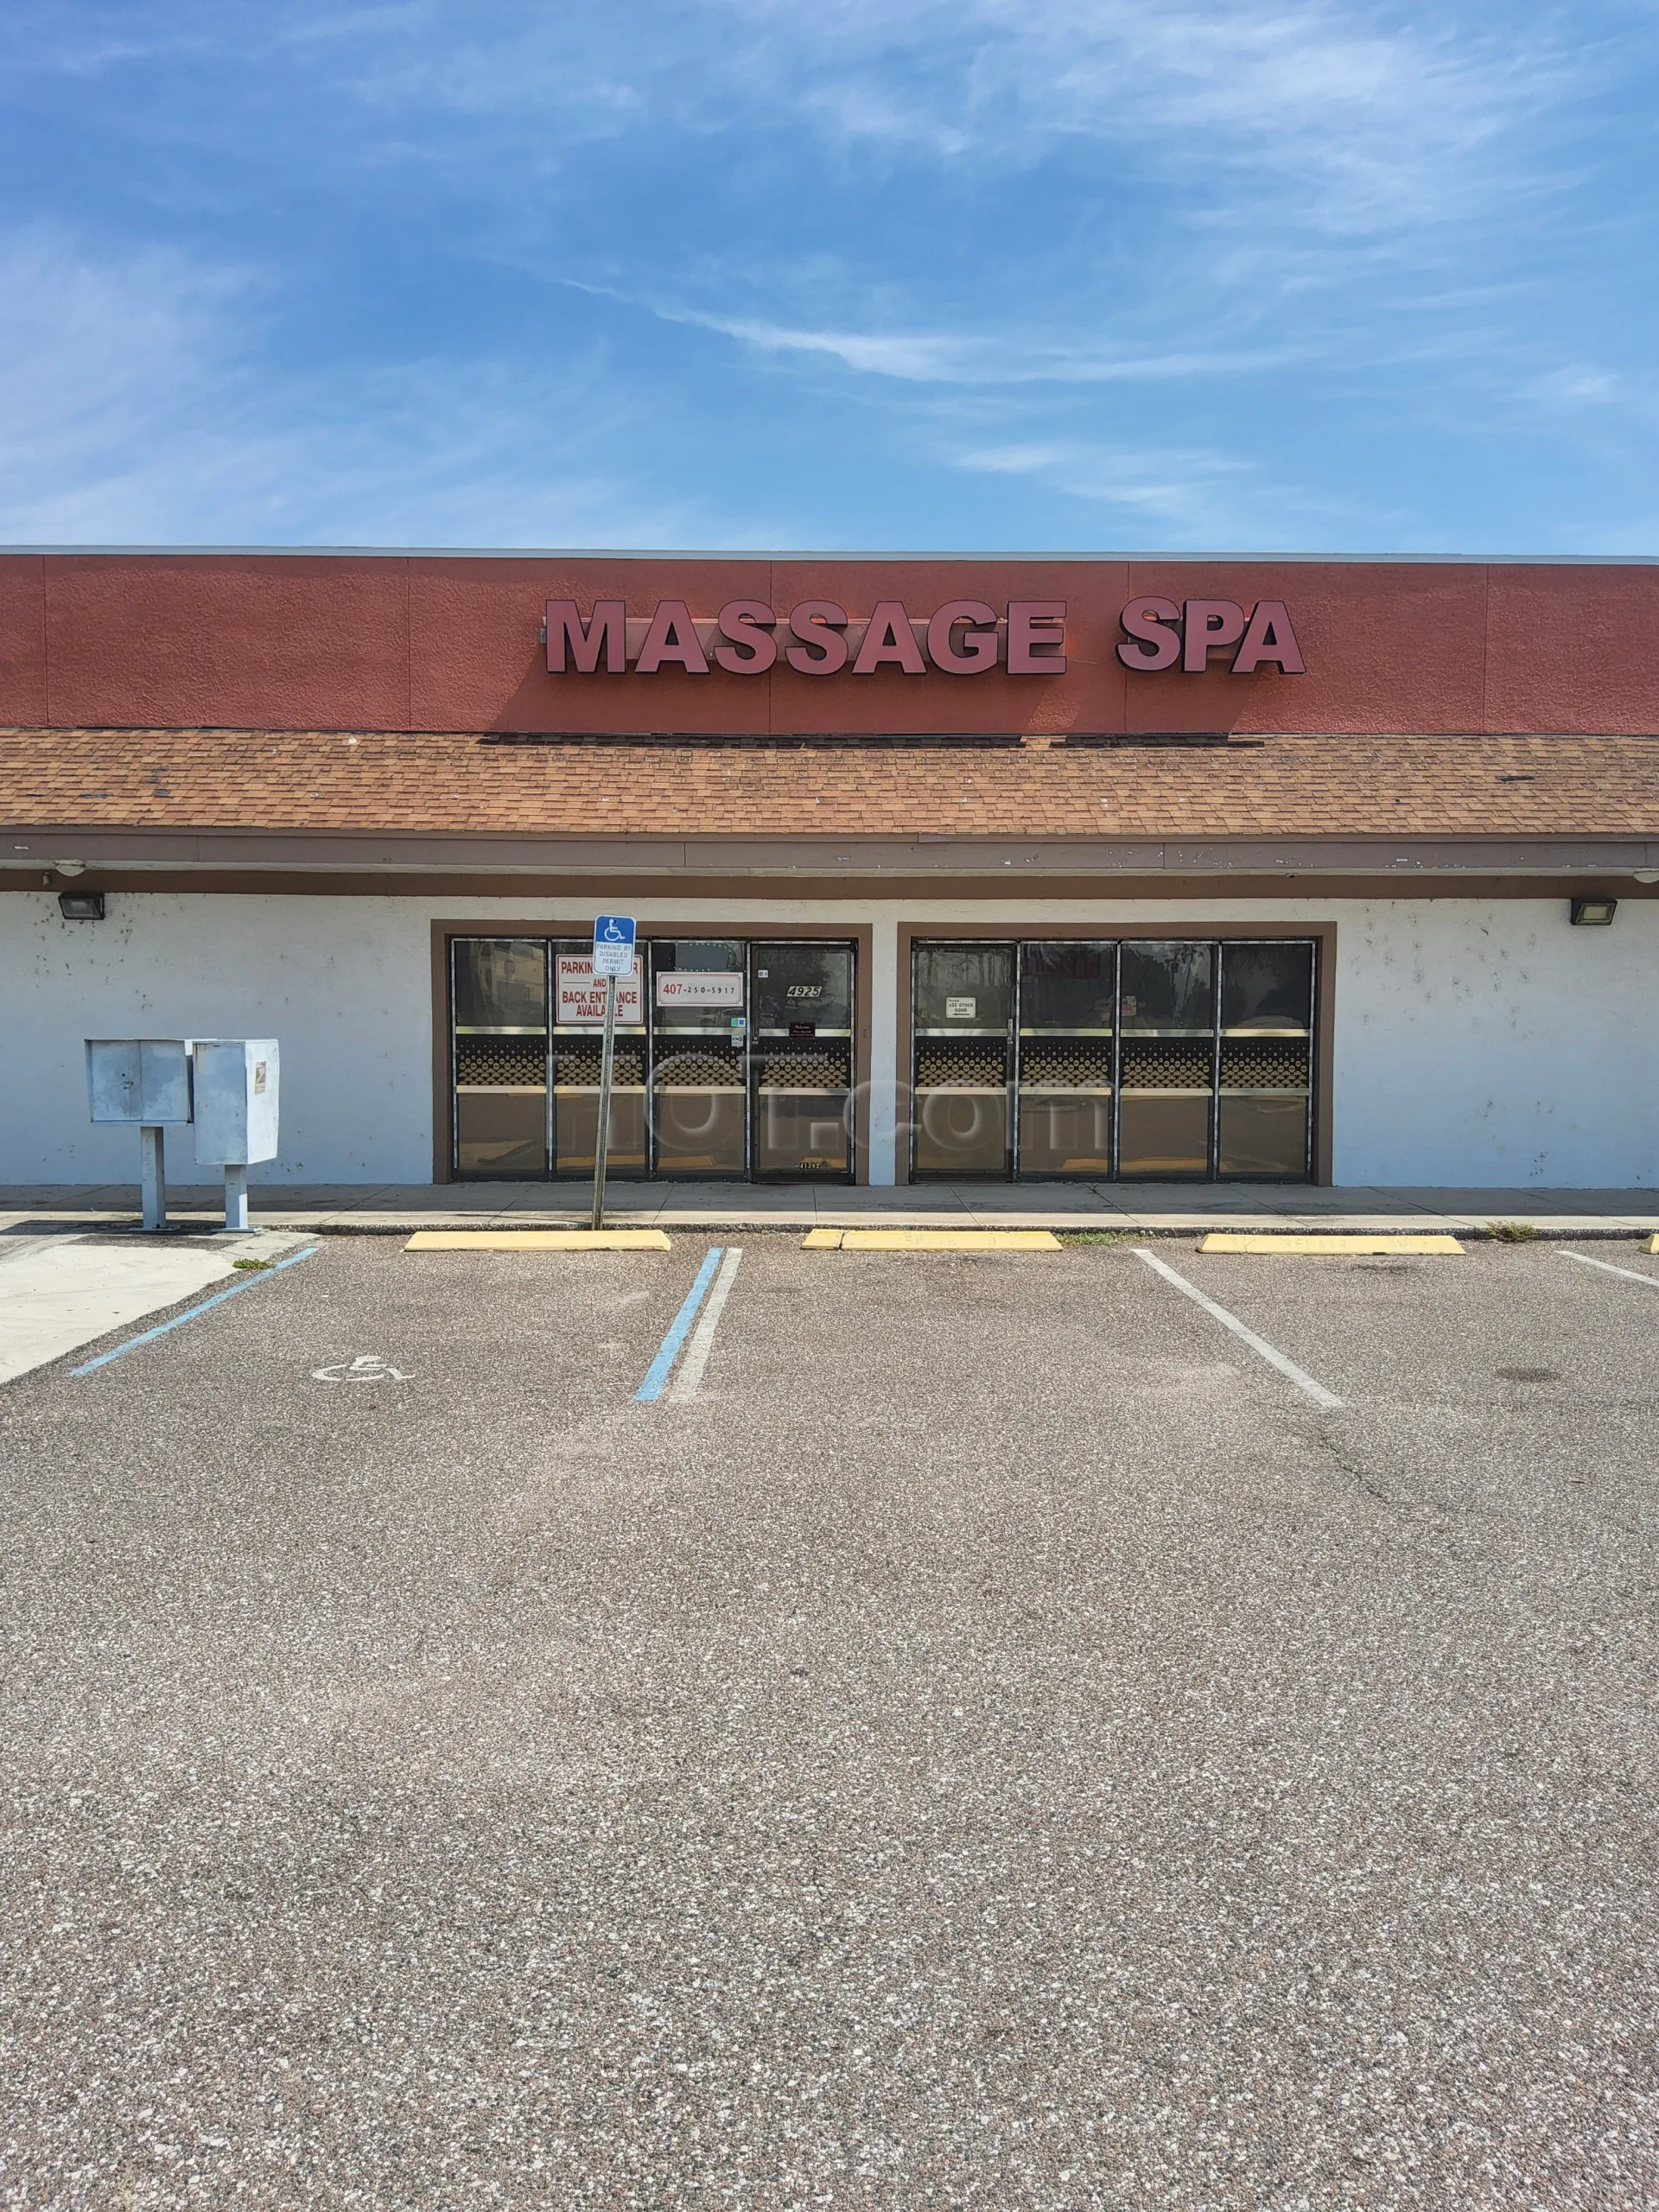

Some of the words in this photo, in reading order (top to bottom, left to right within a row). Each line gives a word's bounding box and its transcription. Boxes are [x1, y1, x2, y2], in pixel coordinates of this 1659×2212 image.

[546, 600, 1067, 676] MASSAGE
[1116, 596, 1307, 674] SPA
[562, 961, 594, 974] PARKIN
[593, 978, 607, 988] AND
[788, 986, 820, 996] 4925
[563, 991, 587, 1003] BACK
[589, 991, 637, 1004] ENTNCE
[576, 1004, 623, 1016] AVAILAE
